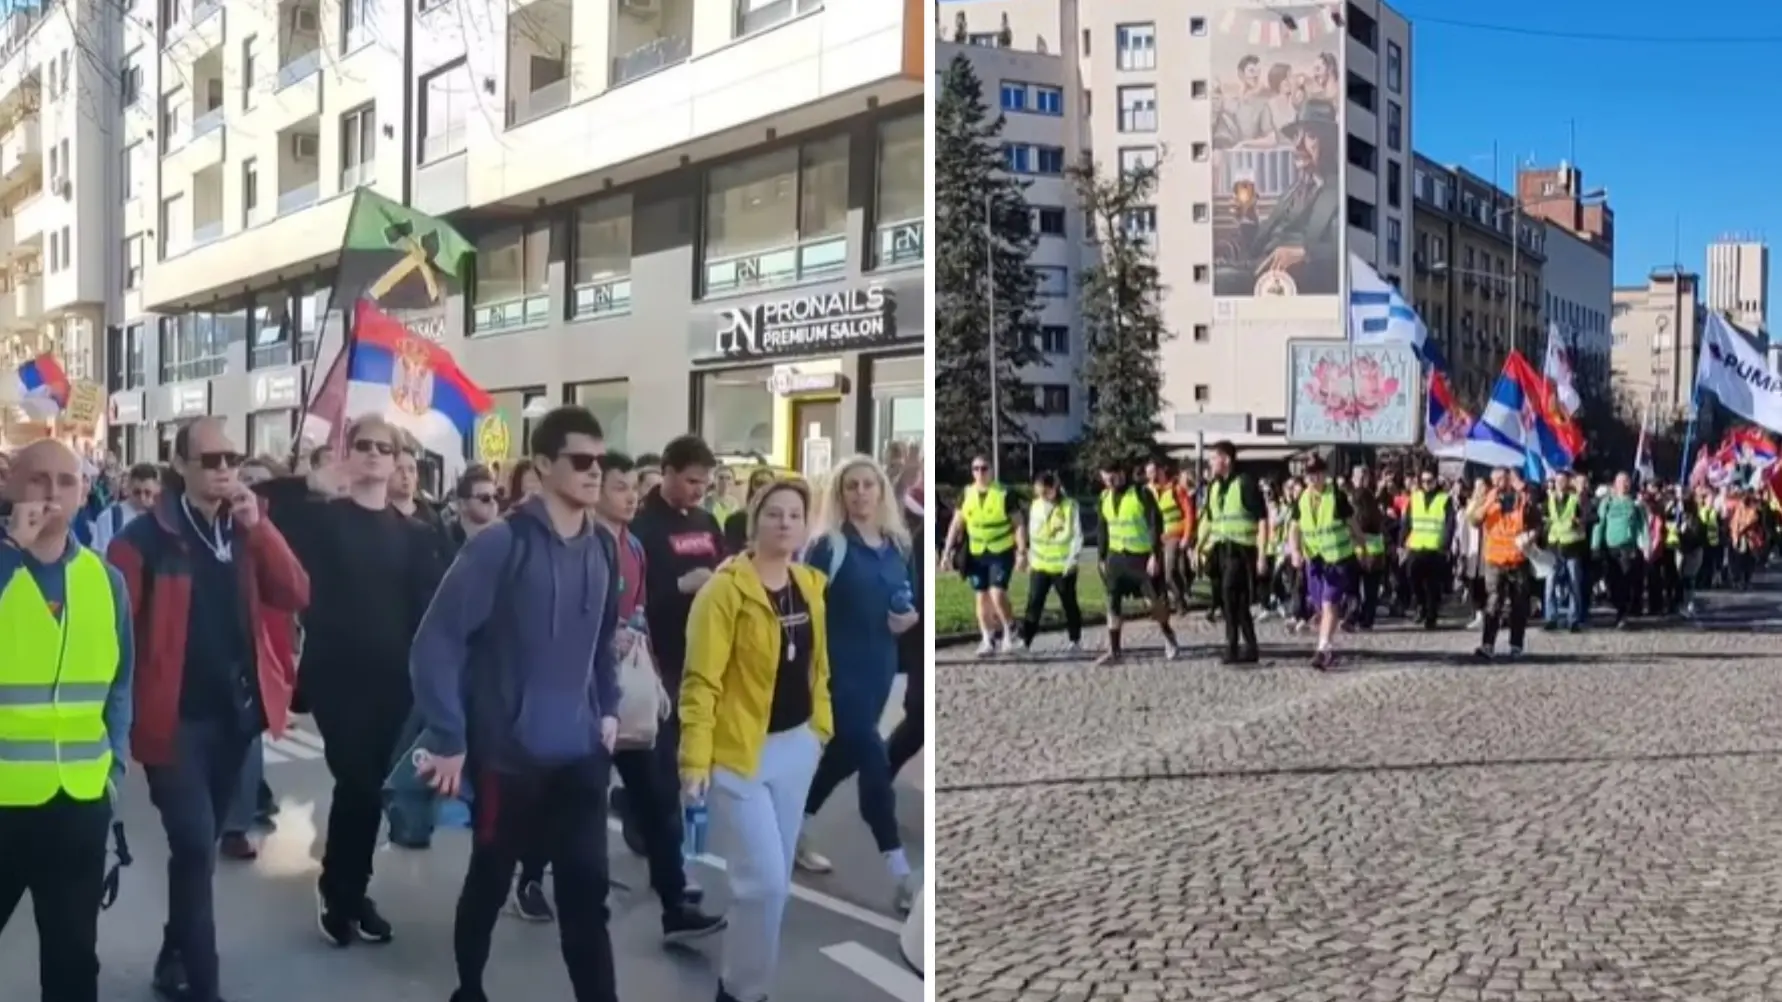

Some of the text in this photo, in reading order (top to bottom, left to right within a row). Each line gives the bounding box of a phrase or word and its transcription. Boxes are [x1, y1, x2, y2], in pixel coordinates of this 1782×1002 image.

[764, 284, 884, 325] PRONAILS
[715, 303, 763, 354] PN
[763, 317, 884, 347] PREMIUM SALON
